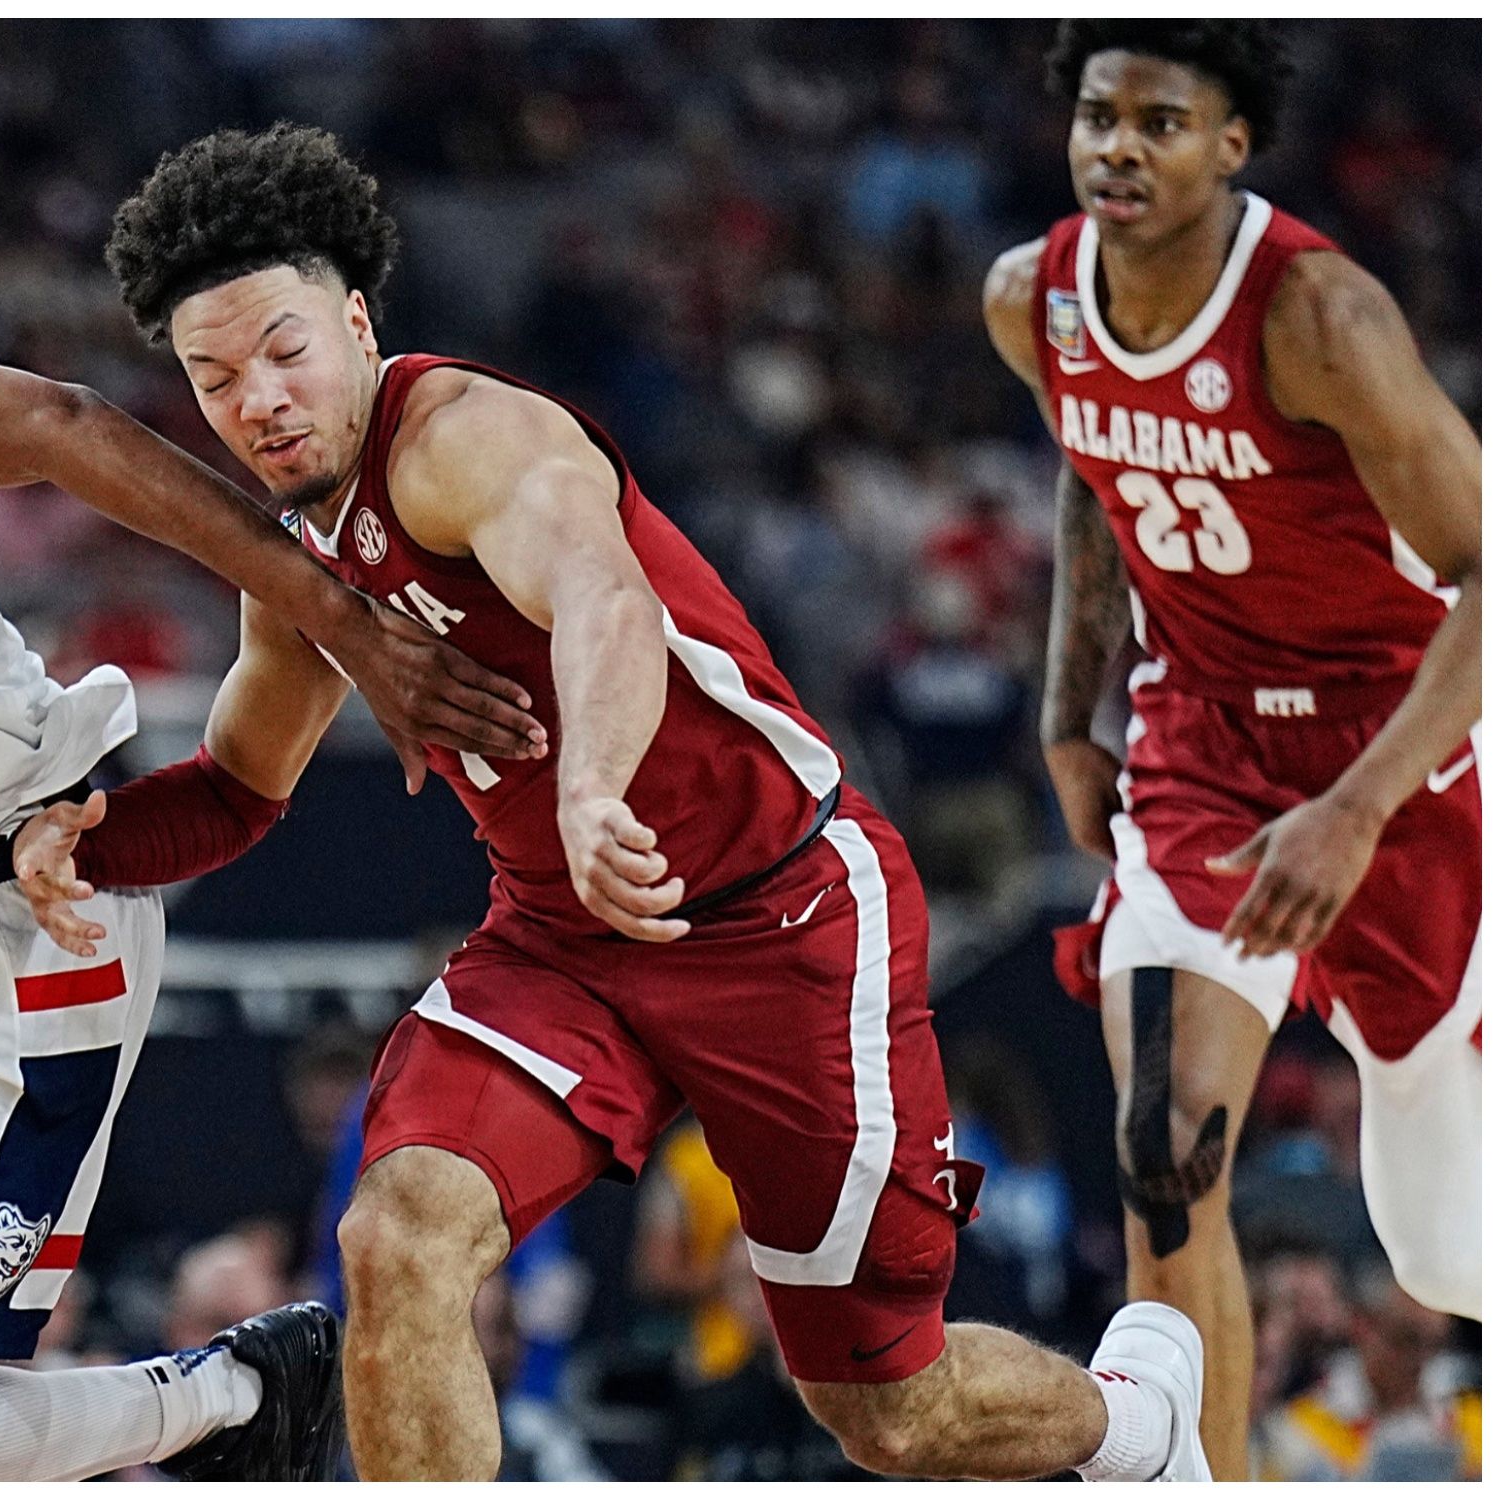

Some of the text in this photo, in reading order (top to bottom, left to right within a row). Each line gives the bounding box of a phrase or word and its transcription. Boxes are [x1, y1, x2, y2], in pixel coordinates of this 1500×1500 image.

[1060, 393, 1273, 480] ALABAMA
[357, 510, 385, 562] SEC
[1116, 470, 1253, 576] 23
